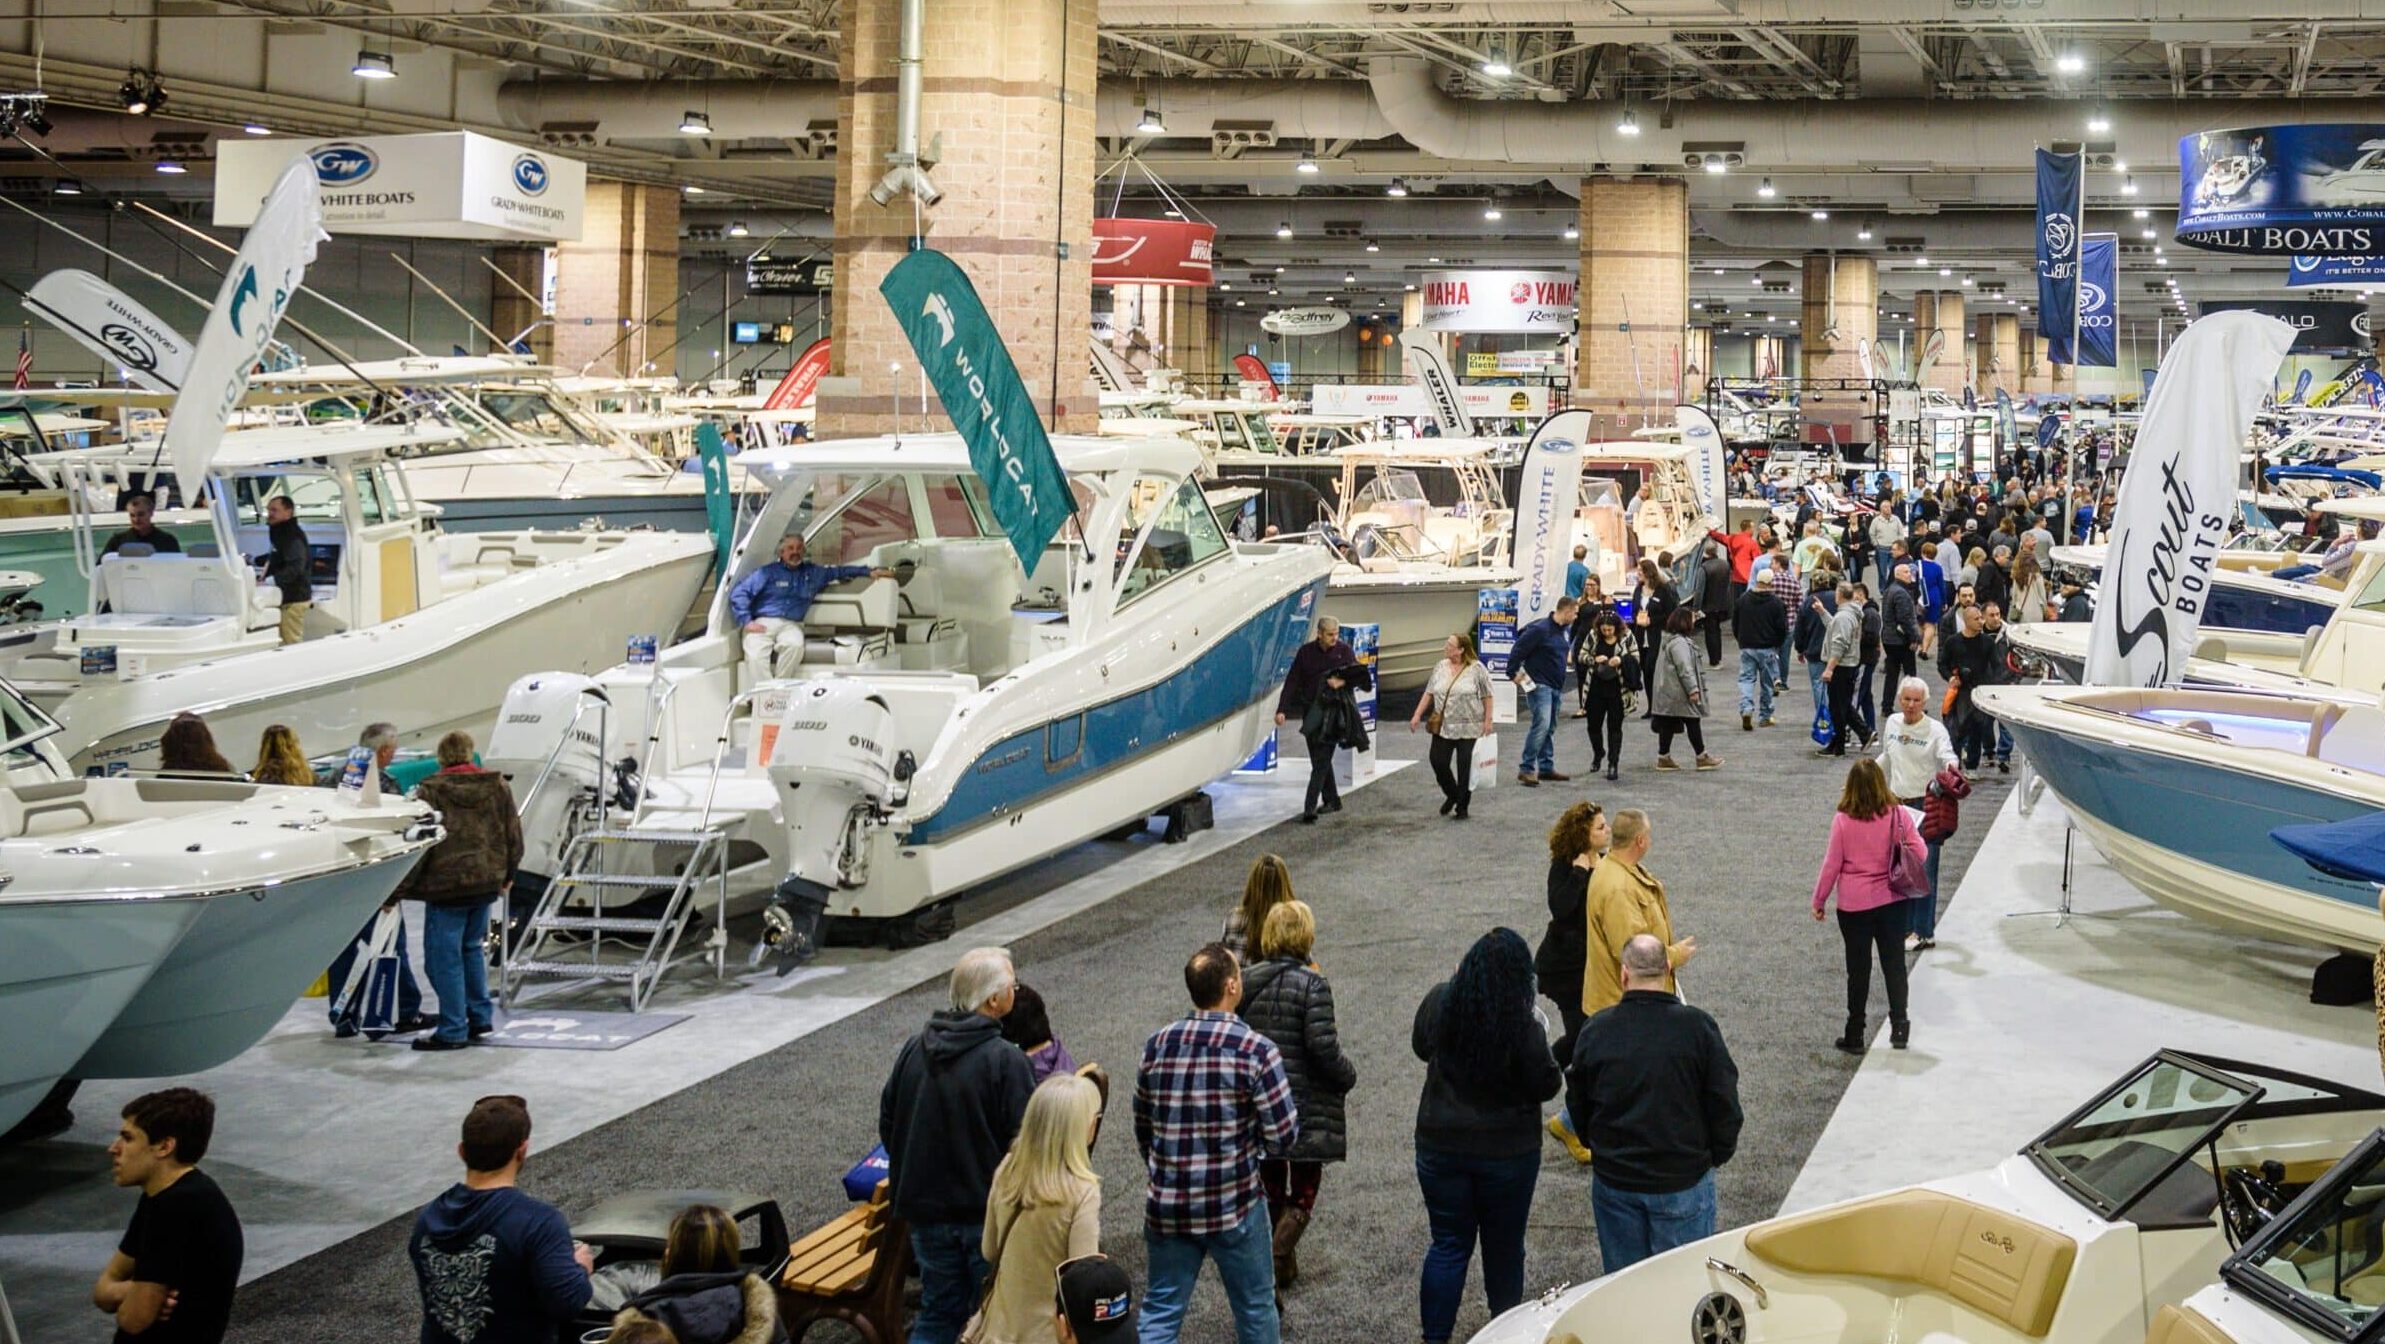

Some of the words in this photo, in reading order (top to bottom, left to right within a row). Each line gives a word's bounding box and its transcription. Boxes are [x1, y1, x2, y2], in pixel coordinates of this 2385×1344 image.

[2263, 228, 2372, 251] BOATS
[2280, 315, 2315, 327] ALO
[1426, 368, 1458, 429] WHALER
[1530, 466, 1556, 613] GRADY-WHITE
[2116, 451, 2195, 688] Scout
[2175, 513, 2224, 615] BOATS
